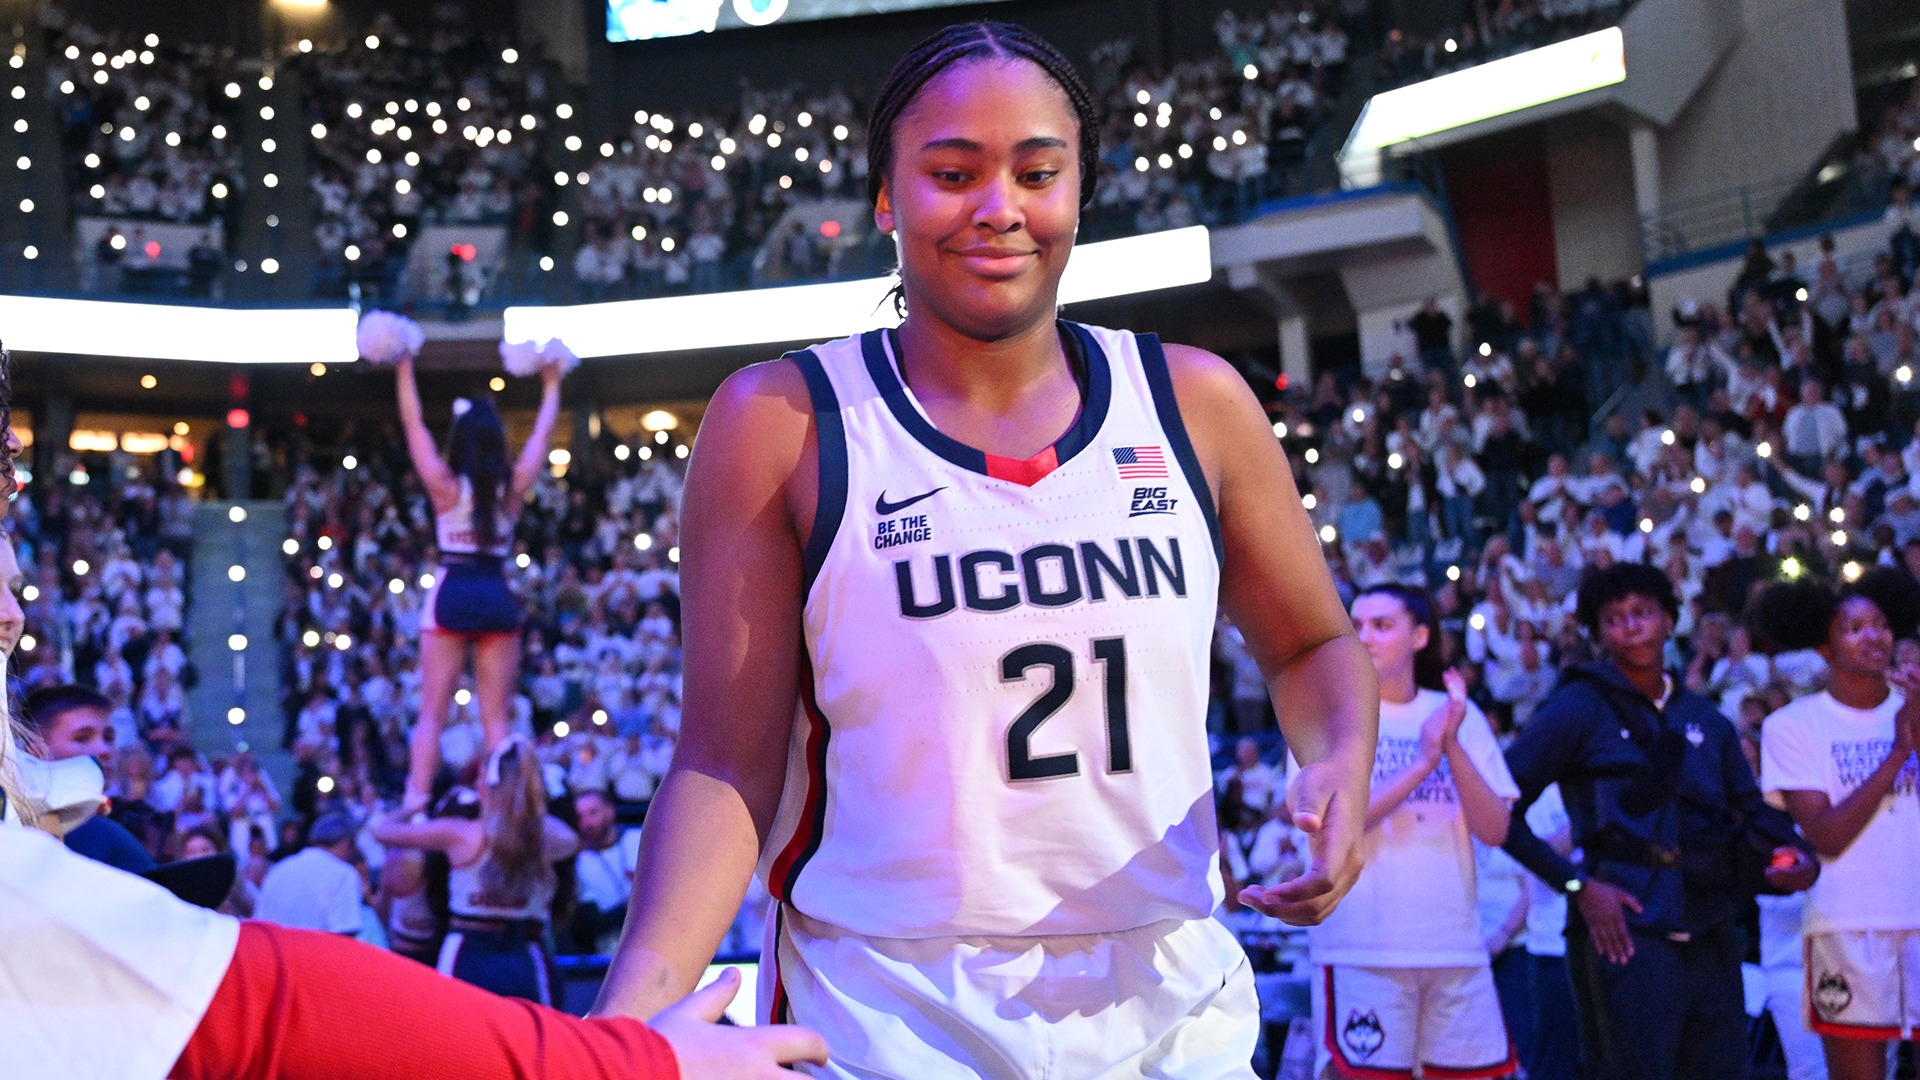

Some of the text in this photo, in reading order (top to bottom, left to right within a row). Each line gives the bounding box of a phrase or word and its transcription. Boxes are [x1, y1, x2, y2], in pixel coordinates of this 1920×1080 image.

[1133, 487, 1167, 499] BIG
[1130, 499, 1178, 511] EAST
[878, 515, 927, 535] BE THE
[874, 528, 932, 549] CHANGE
[894, 537, 1187, 619] UCONN
[1000, 636, 1133, 782] 21
